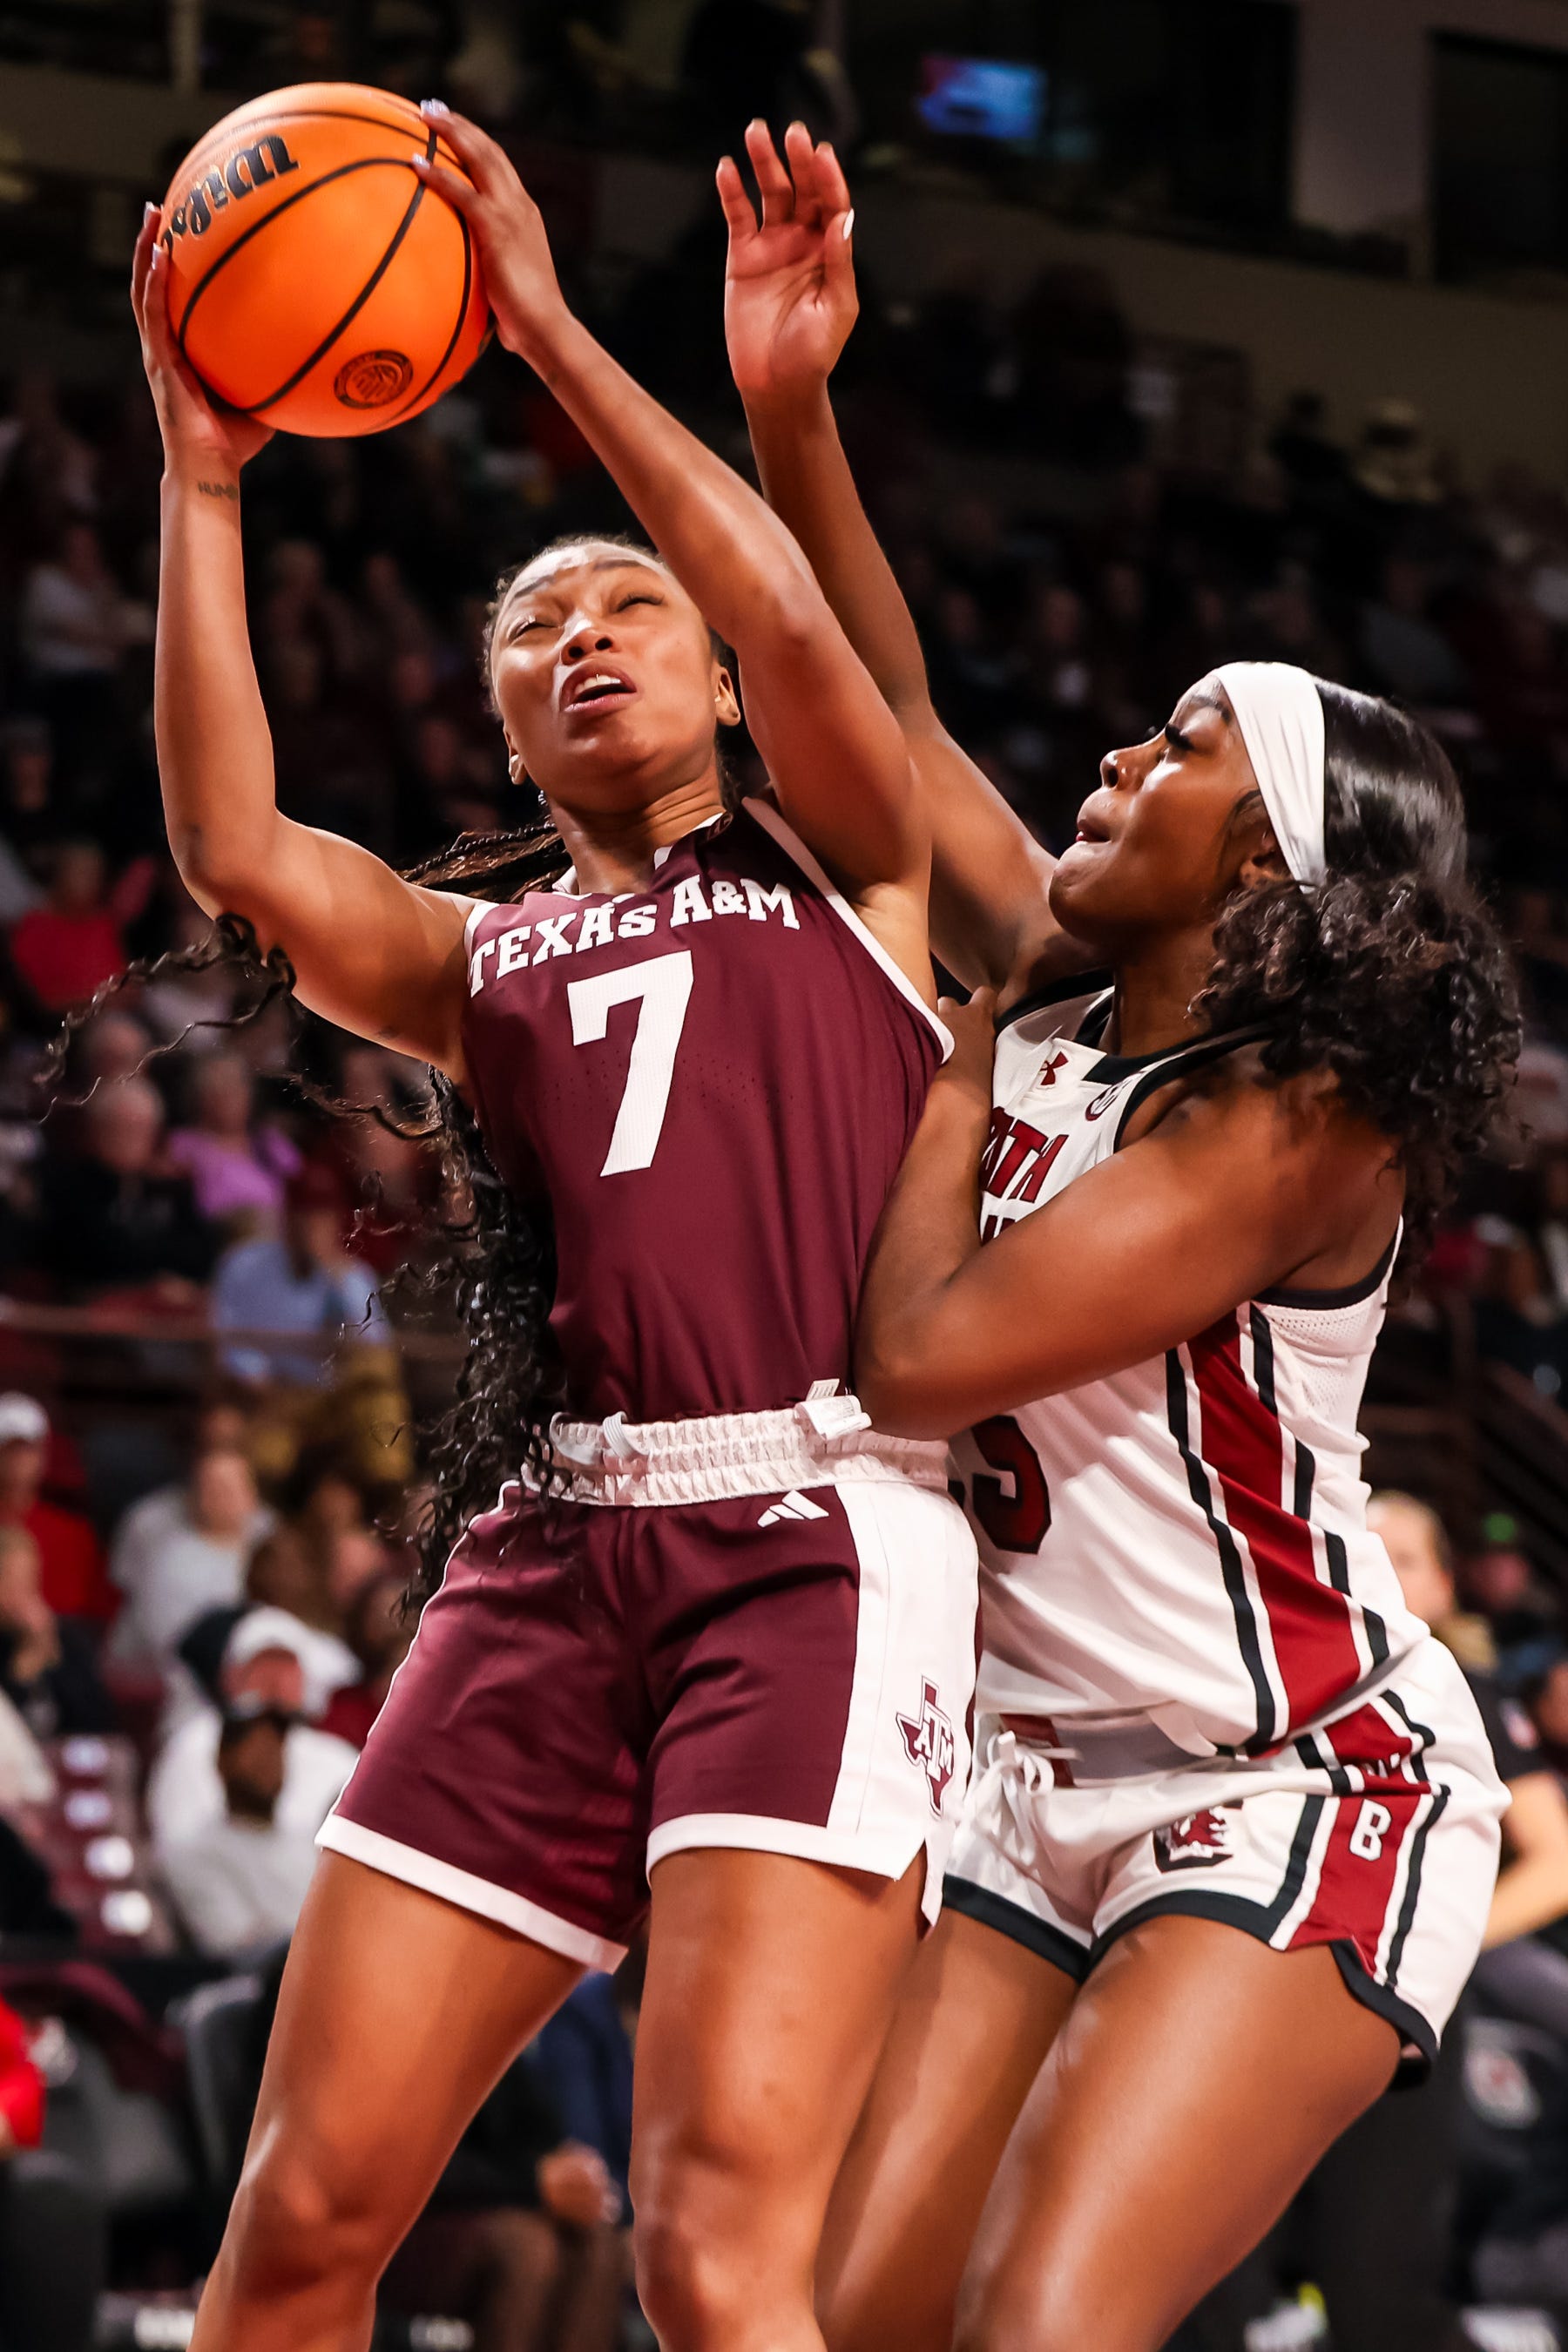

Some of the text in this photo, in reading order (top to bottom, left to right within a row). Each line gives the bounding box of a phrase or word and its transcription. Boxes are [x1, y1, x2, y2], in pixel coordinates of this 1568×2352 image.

[160, 134, 299, 255] Wils
[469, 875, 801, 999] TEXAS A&M
[567, 950, 694, 1177] 7
[1349, 1797, 1392, 1862] B
